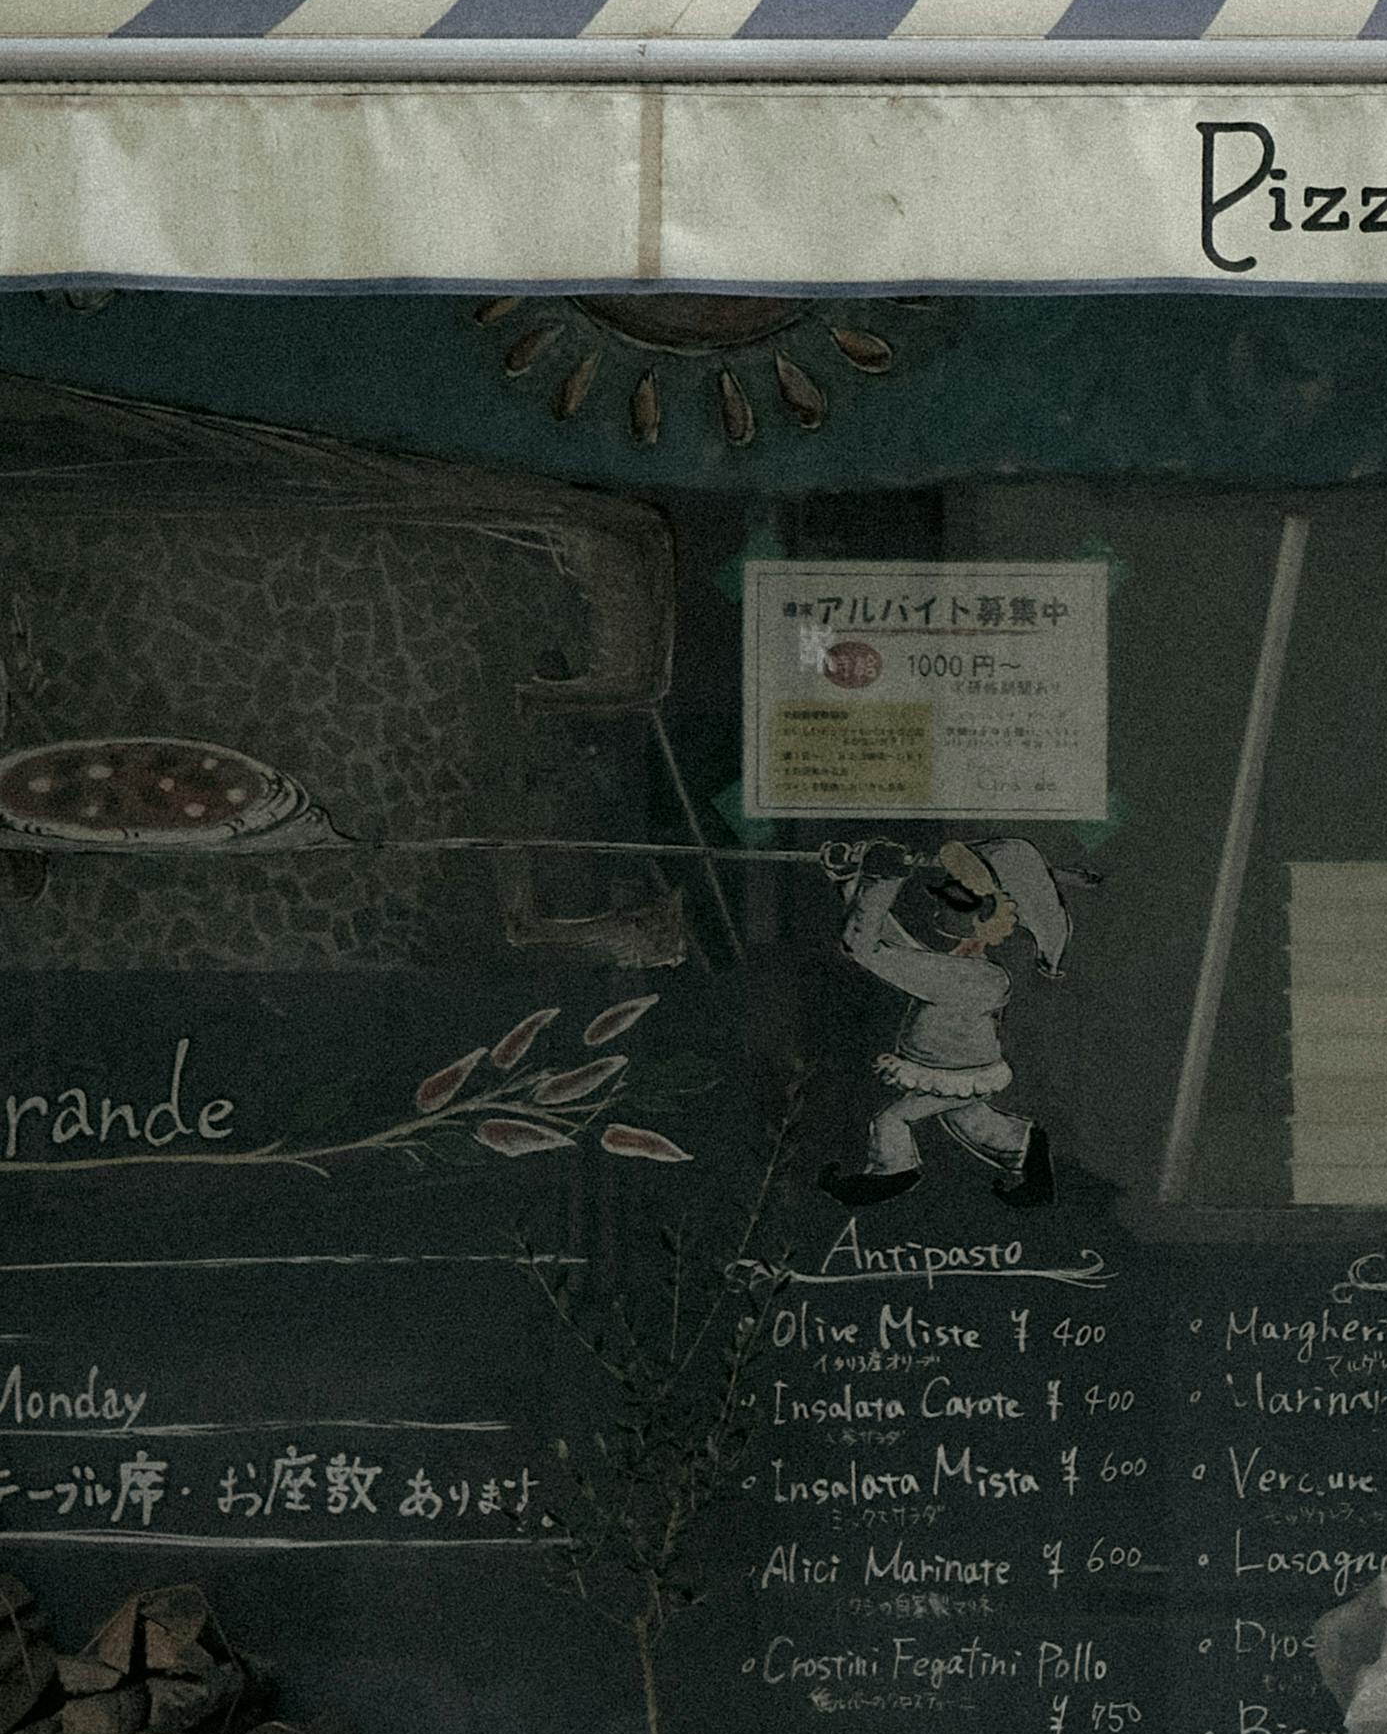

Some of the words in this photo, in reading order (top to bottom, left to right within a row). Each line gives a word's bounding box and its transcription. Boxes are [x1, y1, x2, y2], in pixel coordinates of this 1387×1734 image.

[821, 1216, 1023, 1290] Antipasto
[771, 1300, 859, 1349] Olive
[879, 1303, 982, 1350] Miste
[1052, 1317, 1107, 1348] 400
[773, 1379, 906, 1426] Insalata
[921, 1375, 1025, 1420] Carote
[1084, 1385, 1134, 1415] 400
[770, 1458, 921, 1506] Insalata
[933, 1444, 1041, 1498] Mista
[1100, 1453, 1147, 1482] 600
[761, 1543, 840, 1589] Alici
[864, 1542, 1011, 1585] Marinate
[1086, 1538, 1142, 1573] 600
[763, 1636, 878, 1683] Crostini
[893, 1637, 1021, 1689] Fegatini
[1038, 1642, 1107, 1688] Pollo
